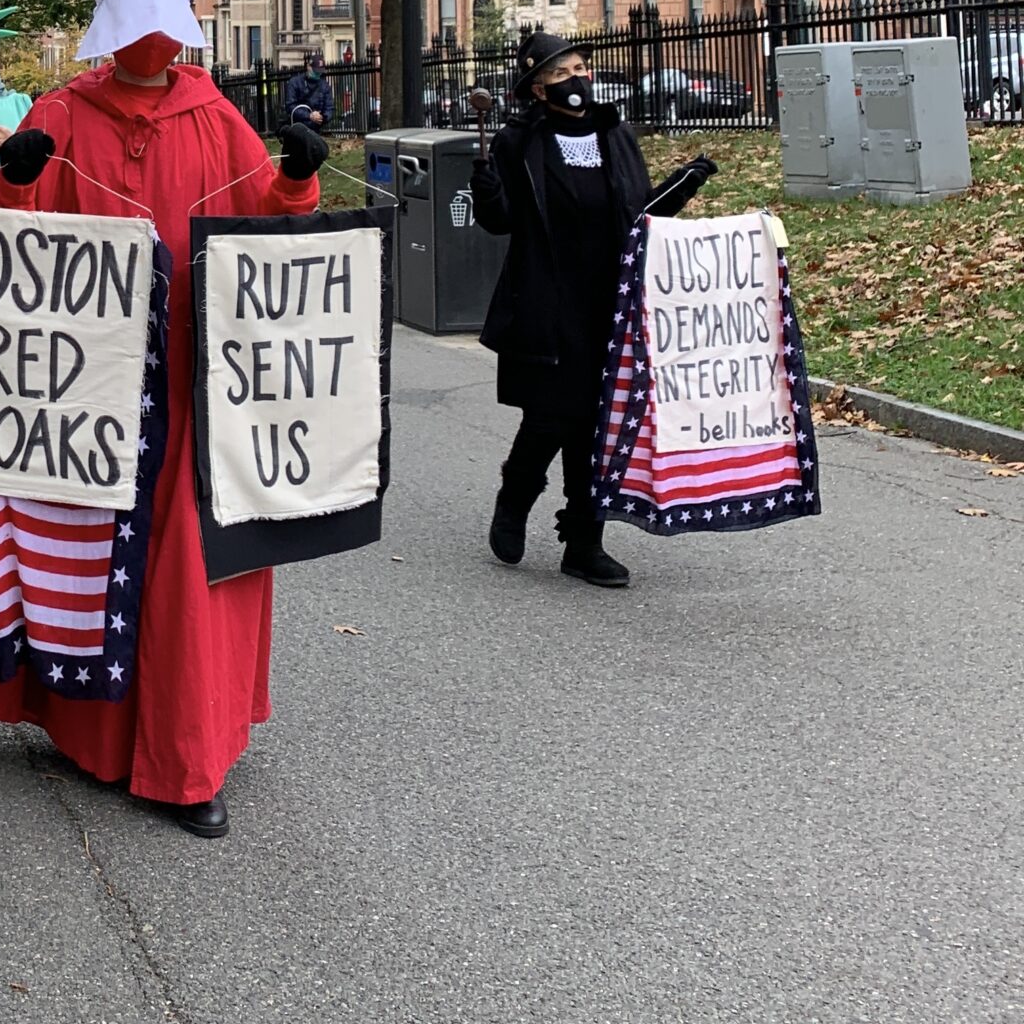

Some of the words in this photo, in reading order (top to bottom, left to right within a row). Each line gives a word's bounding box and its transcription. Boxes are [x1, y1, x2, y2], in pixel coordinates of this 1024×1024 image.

[236, 253, 350, 320] RUTH
[655, 231, 763, 294] JUSTICE
[655, 297, 769, 352] DEMANDS
[222, 336, 353, 405] SENT
[655, 355, 778, 403] INTEGRITY
[252, 420, 310, 487] US
[700, 412, 735, 443] bell
[743, 402, 792, 437] hooks
